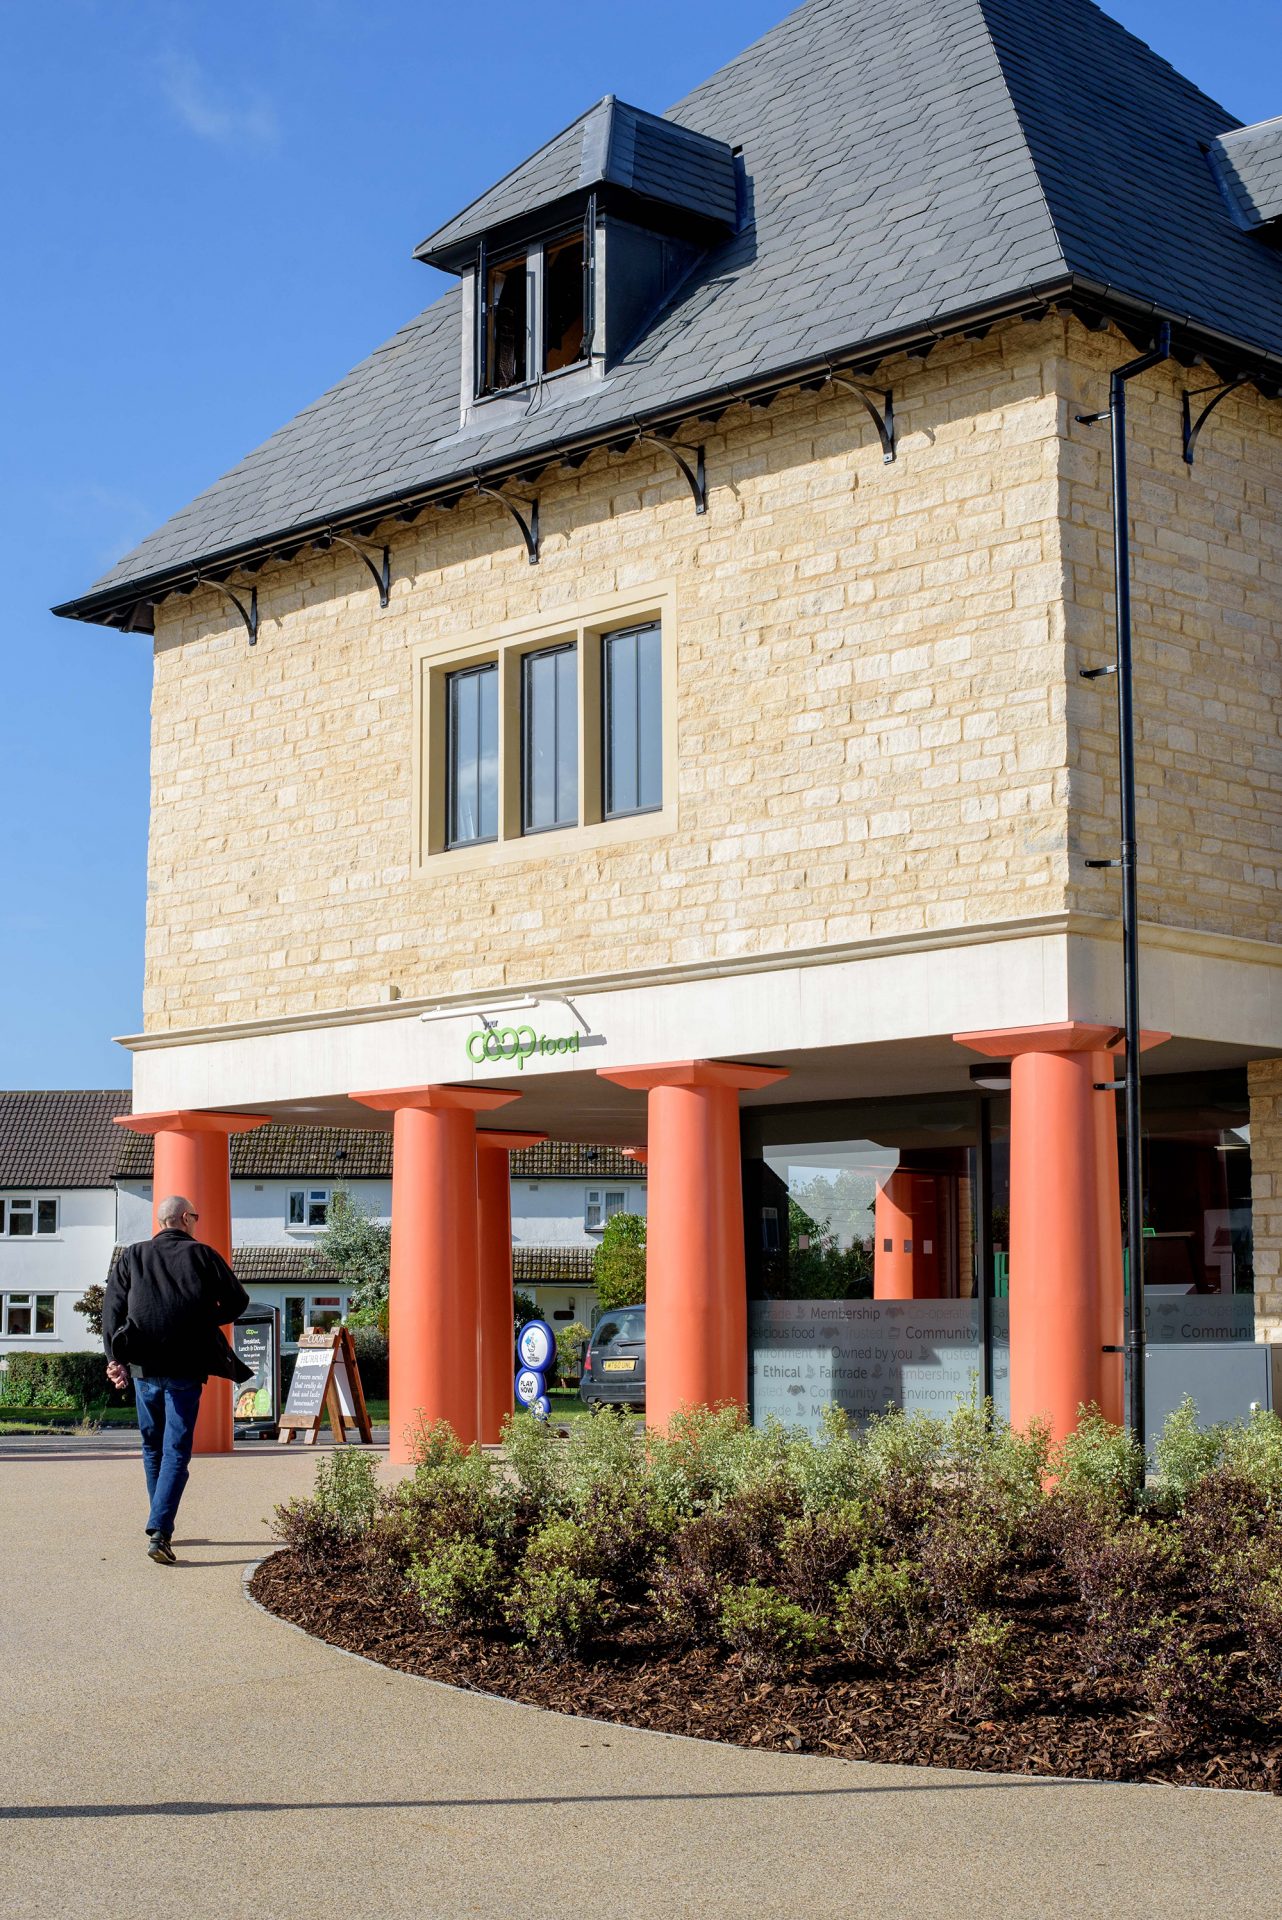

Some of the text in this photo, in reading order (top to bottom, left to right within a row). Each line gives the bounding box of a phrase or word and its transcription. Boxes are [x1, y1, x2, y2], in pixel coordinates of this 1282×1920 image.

[540, 1031, 580, 1056] food
[810, 1306, 880, 1322] Membership
[752, 1325, 790, 1339] elicious
[791, 1326, 815, 1339] food
[845, 1326, 883, 1340] Trusted
[905, 1325, 978, 1342] Community
[1181, 1323, 1254, 1339] Communi
[831, 1345, 872, 1360] Owned
[875, 1346, 886, 1362] by
[891, 1349, 913, 1362] you
[763, 1364, 961, 1383] Ethical Fairtrade Membership
[809, 1384, 878, 1400] Community
